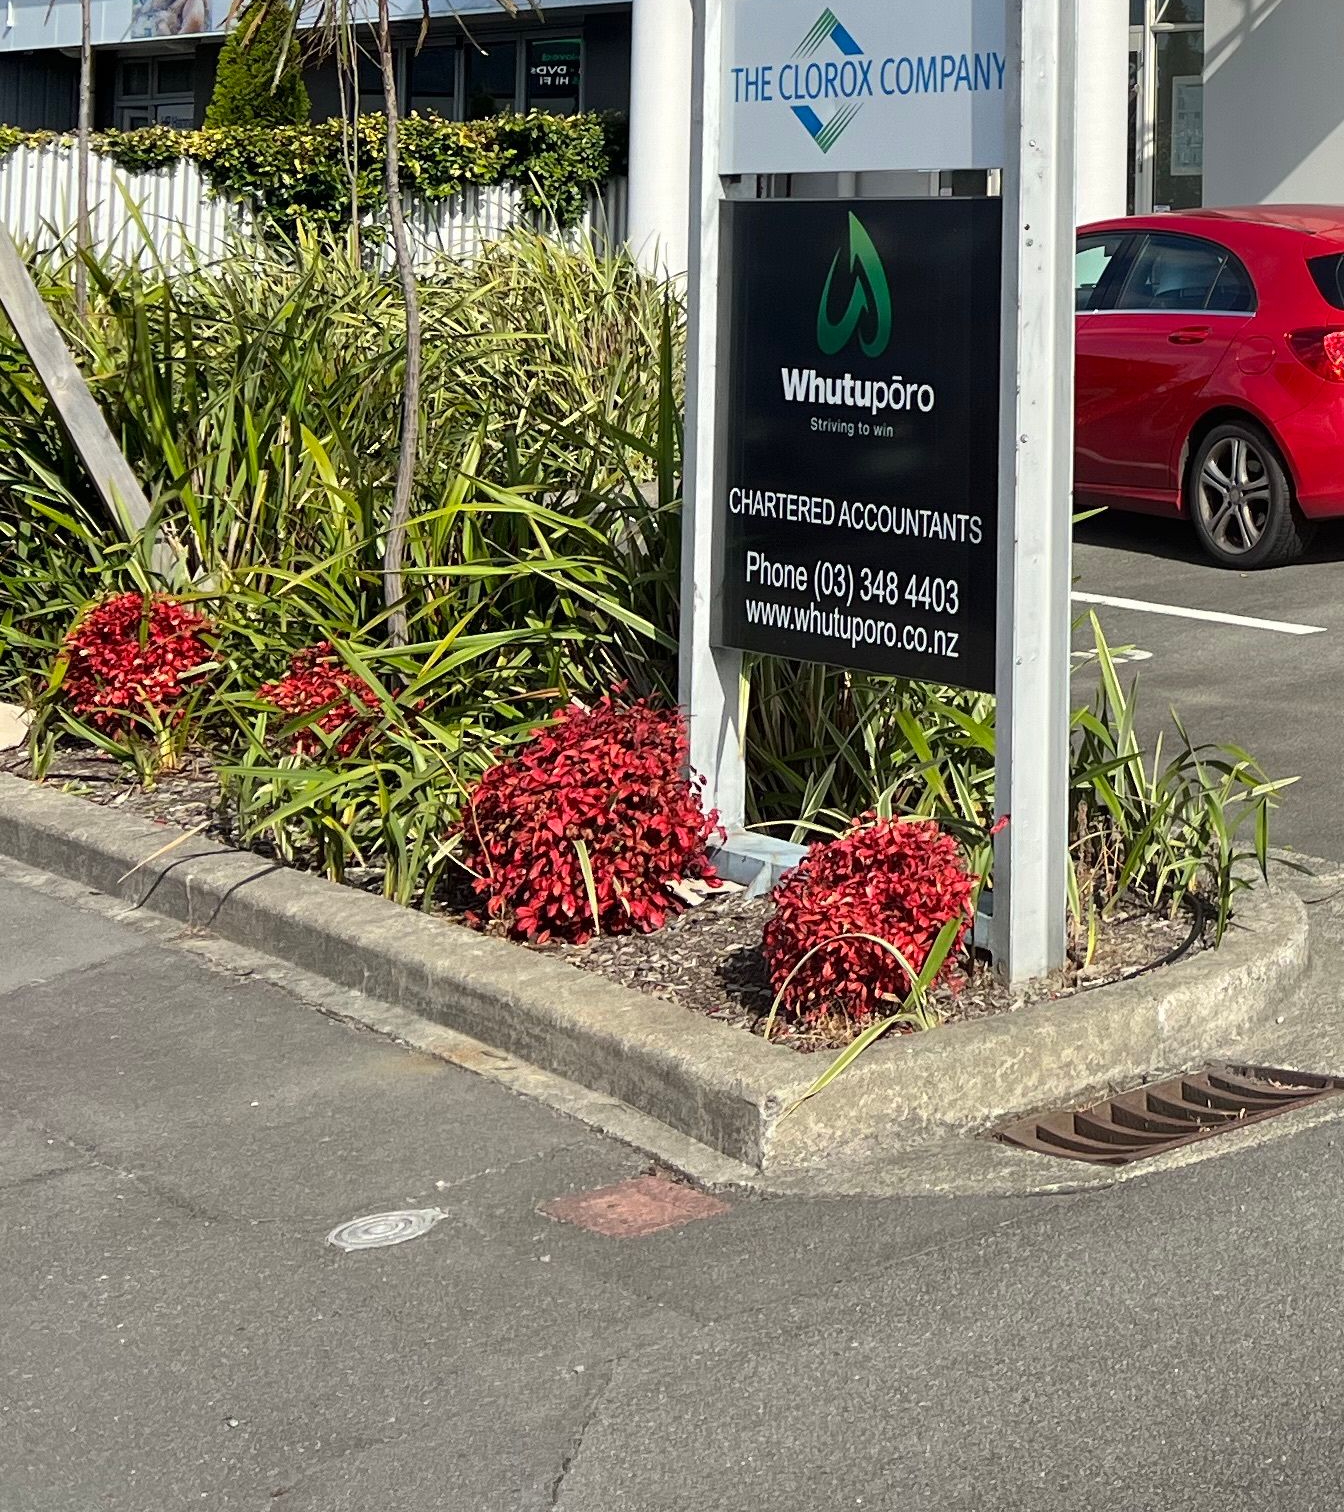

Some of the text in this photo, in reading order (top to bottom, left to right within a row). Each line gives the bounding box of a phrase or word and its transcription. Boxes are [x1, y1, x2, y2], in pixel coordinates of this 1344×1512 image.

[731, 51, 1006, 103] THE CLOROX COMPANY
[781, 367, 935, 416] Whutupōro
[810, 417, 894, 438] Striving to win
[729, 487, 983, 544] CHARTERED ACCOUNTANTS
[746, 550, 959, 615] Phone (03) 348 4403
[745, 598, 959, 658] www.whutuporo.co.nz
